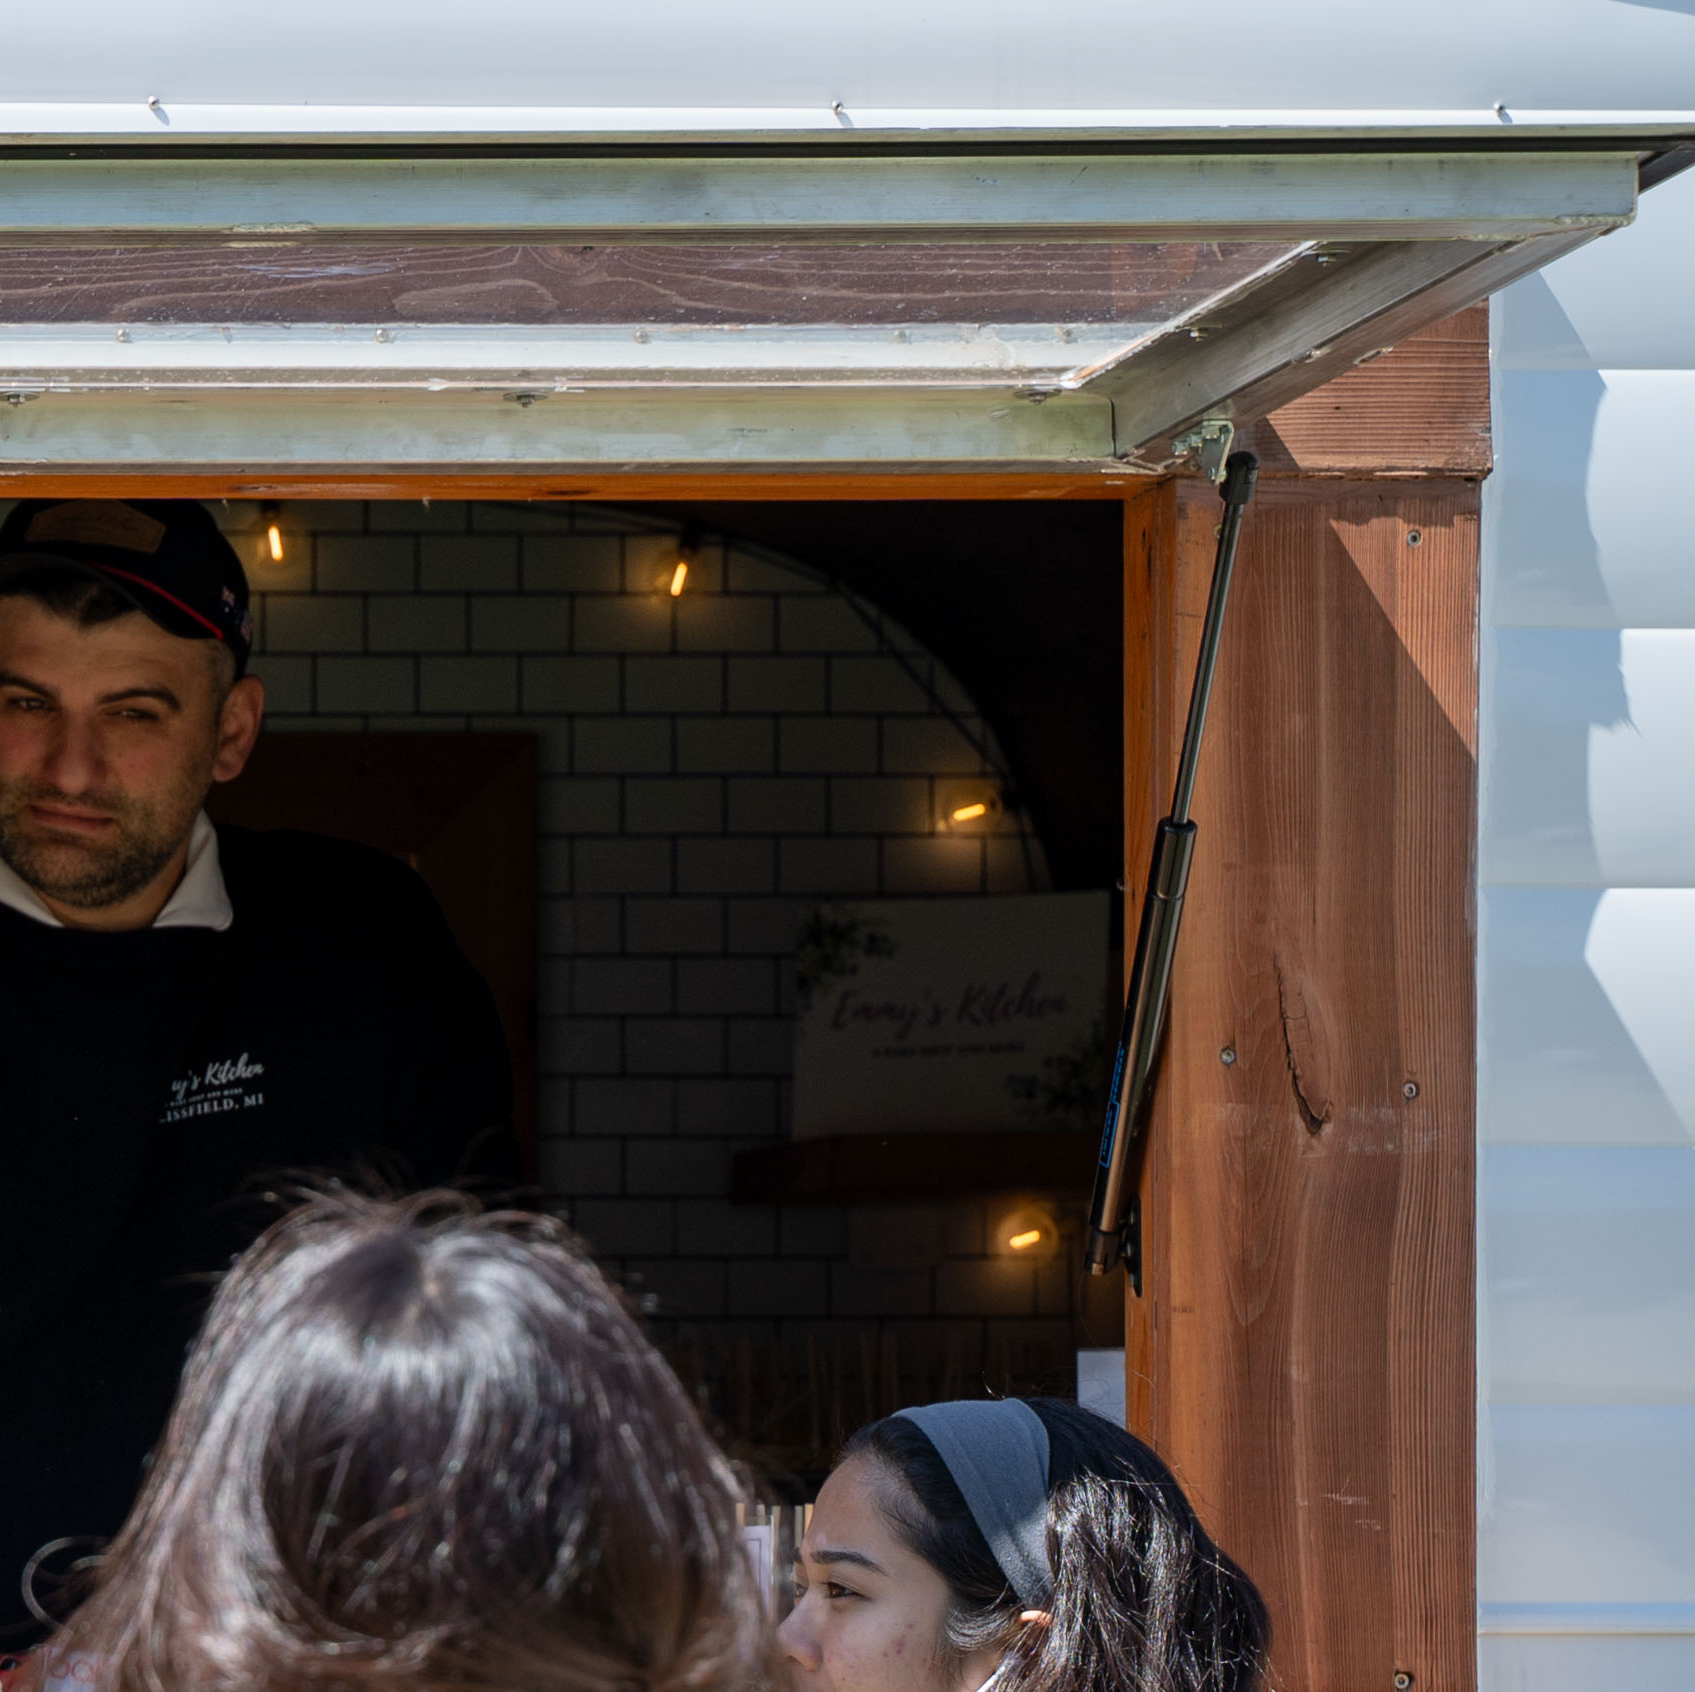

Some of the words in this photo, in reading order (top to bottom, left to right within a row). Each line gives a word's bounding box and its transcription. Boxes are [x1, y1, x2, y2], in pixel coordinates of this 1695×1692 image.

[957, 971, 1067, 1026] Kitchen
[205, 1052, 265, 1085] Kitchen
[159, 1098, 239, 1123] ISSFIELD,
[244, 1093, 264, 1107] MI
